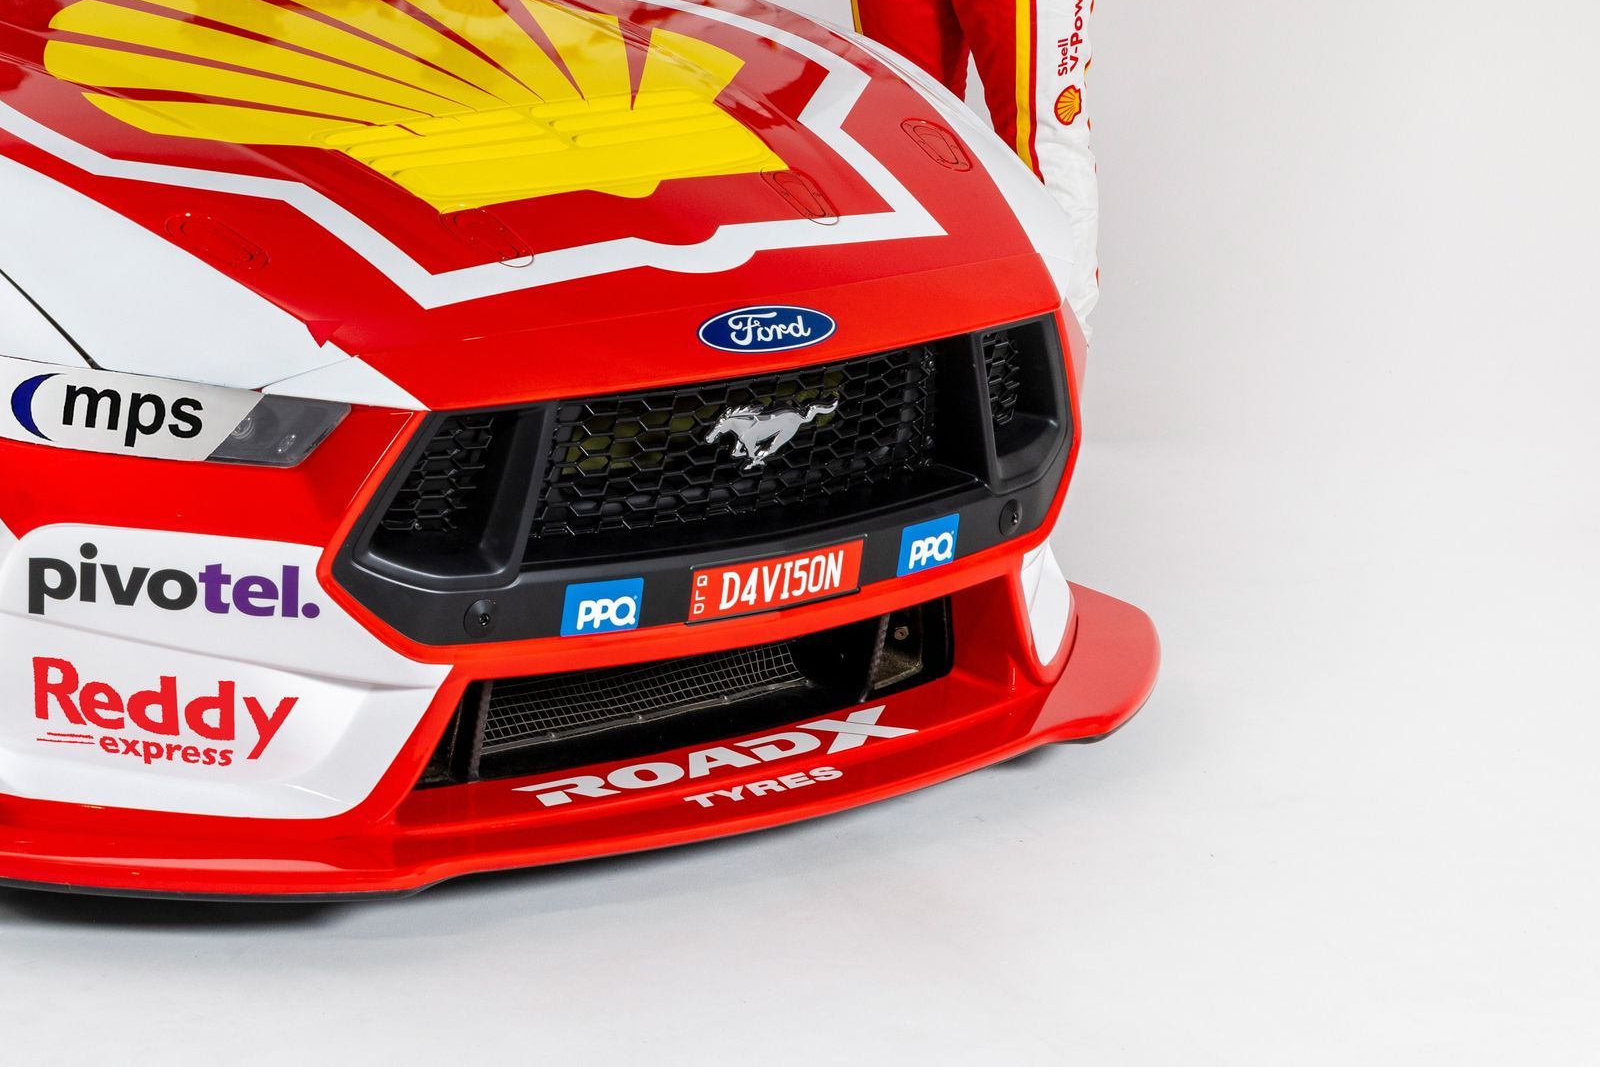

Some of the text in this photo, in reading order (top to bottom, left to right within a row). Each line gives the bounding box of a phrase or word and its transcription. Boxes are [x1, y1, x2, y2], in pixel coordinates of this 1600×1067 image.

[1057, 38, 1068, 76] Shell
[61, 382, 204, 447] mps
[909, 532, 952, 569] PPQ
[27, 542, 320, 619] pivotel.
[576, 595, 636, 630] PPQ
[32, 656, 299, 760] Reddy
[99, 735, 233, 767] express
[512, 704, 919, 808] ROADX
[684, 766, 844, 809] TYRES
